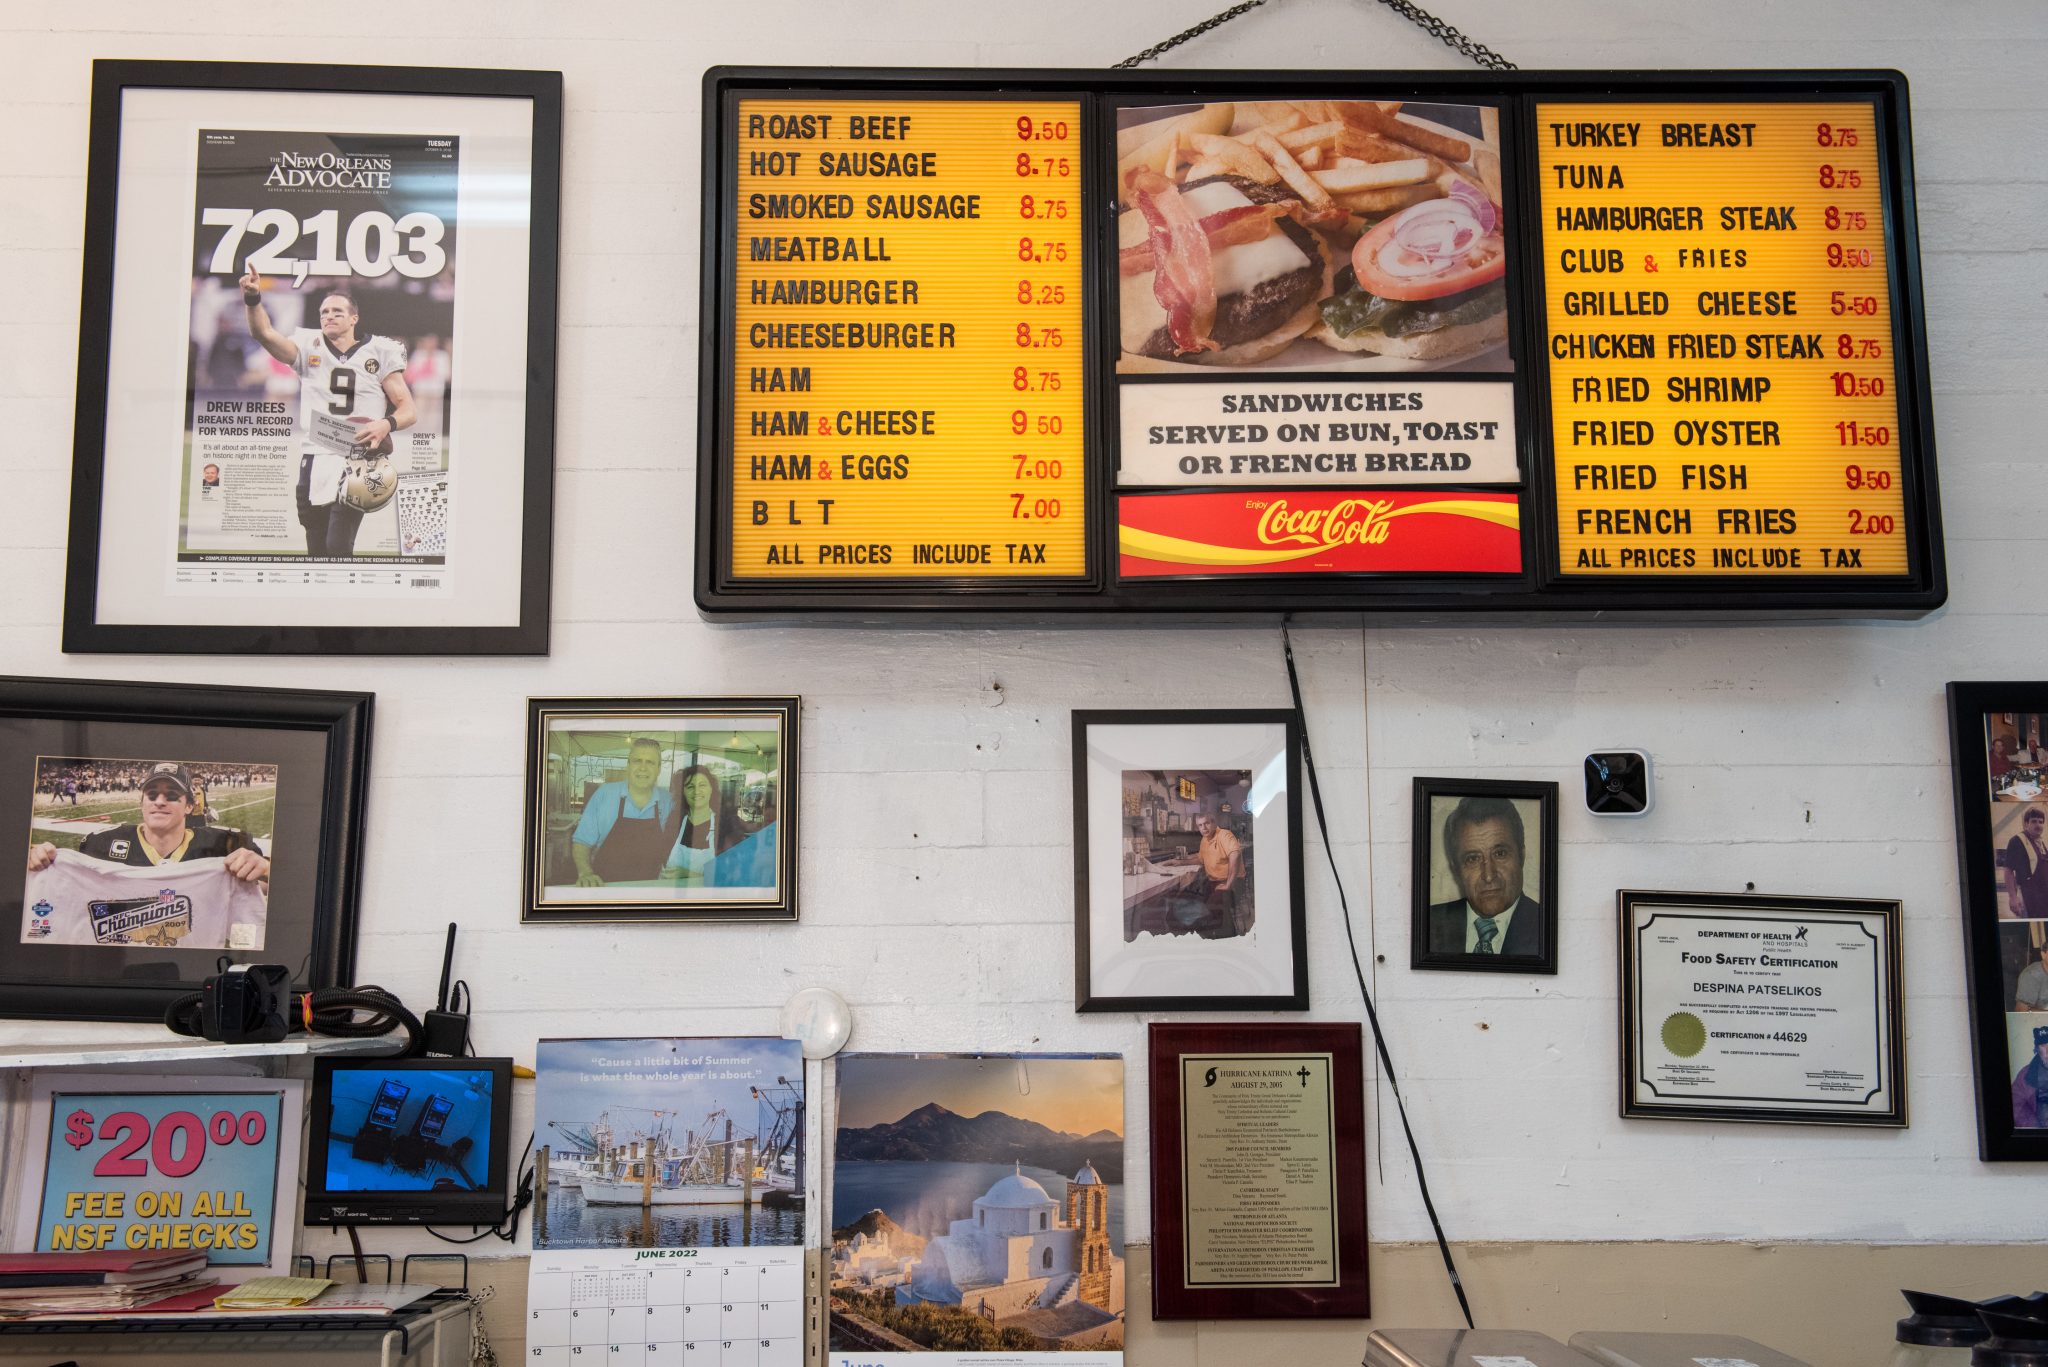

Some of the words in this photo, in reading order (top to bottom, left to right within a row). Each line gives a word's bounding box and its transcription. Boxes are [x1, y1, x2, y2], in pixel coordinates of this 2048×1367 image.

[749, 114, 832, 140] ROAST
[850, 116, 912, 140] BEEF
[1016, 116, 1068, 141] 9.50
[1550, 122, 1641, 148] TURKEY
[1662, 123, 1757, 148] BREAST
[1817, 122, 1858, 147] 8.75
[264, 163, 391, 189] ADVOCATE
[750, 151, 800, 177] HOT
[819, 152, 937, 177] SAUSAGE
[1016, 152, 1070, 177] 8.75
[1553, 165, 1624, 190] TUNA
[1819, 164, 1861, 189] 8.75
[749, 194, 854, 220] SMOKED
[866, 195, 981, 220] SAUSAGE
[1020, 194, 1068, 219] 8.75
[1556, 206, 1703, 232] HAMBURGER
[1721, 206, 1798, 232] STEAK
[202, 208, 446, 289] 72,103
[750, 236, 891, 262] MEATBALL
[1560, 249, 1624, 274] CLUB
[1644, 254, 1659, 273] &
[1678, 249, 1748, 269] FRIES
[1826, 243, 1872, 268] 9.50
[751, 280, 919, 306] HAMBURGER
[1017, 279, 1065, 305] 8.25
[1564, 291, 1669, 316] GRILLED
[1698, 291, 1798, 316] CHEESE
[749, 323, 956, 348] CHEESEBURGER
[1016, 322, 1063, 348] 8.75
[1551, 333, 1655, 360] CHICKEN
[1668, 334, 1737, 360] FRIED
[1746, 334, 1824, 360] STEAK
[1837, 333, 1882, 359] 8.75
[328, 367, 356, 416] 9
[750, 367, 812, 393] HAM
[1013, 366, 1061, 391] 8.75
[1572, 376, 1649, 403] FRIED
[1667, 376, 1771, 403] SHRIMP
[1830, 372, 1884, 397] 10.50
[207, 401, 243, 413] DREW
[246, 402, 286, 413] BREES
[1222, 392, 1423, 413] SANDWICHES
[198, 415, 234, 425] BREAKS
[237, 416, 253, 425] NFL
[256, 416, 293, 425] RECORD
[199, 427, 217, 436] FOR
[220, 427, 249, 436] YARDS
[252, 427, 291, 437] PASSING
[751, 410, 809, 437] HAM
[818, 418, 832, 437] &
[836, 410, 936, 436] CHEESE
[1572, 420, 1654, 447] FRIED
[1674, 419, 1781, 446] OYSTER
[1835, 421, 1890, 446] 11.50
[1149, 424, 1269, 445] SERVED
[1277, 424, 1320, 443] ON
[235, 452, 250, 460] night
[273, 445, 288, 453] great
[751, 454, 812, 481] HAM
[818, 461, 832, 480] &
[842, 454, 910, 480] EGGS
[1012, 454, 1062, 479] 7.00
[1178, 455, 1223, 474] OR
[1230, 454, 1360, 473] FRENCH
[1364, 452, 1472, 472] BREAD
[1574, 465, 1657, 490] FRIED
[1682, 464, 1748, 490] FISH
[1845, 464, 1891, 490] 9.50
[1010, 493, 1061, 518] 7.00
[1245, 499, 1268, 510] Enjoy
[1257, 498, 1395, 545] Coca-Cola
[1577, 509, 1692, 535] FRENCH
[1718, 508, 1797, 535] FRIES
[767, 544, 804, 565] ALL
[819, 544, 892, 565] PRICES
[913, 544, 992, 564] INCLUDE
[1006, 544, 1047, 564] TAX
[1577, 548, 1611, 569] ALL
[1620, 548, 1696, 569] PRICES
[1713, 548, 1801, 569] INCLUDE
[1821, 548, 1863, 569] TAX
[97, 899, 186, 937] Champions
[165, 920, 186, 928] 2009
[1698, 930, 1748, 939] DEPARTMENT
[1693, 983, 1744, 994] DESPINA
[1748, 984, 1822, 996] PATSELIKOS
[1710, 1031, 1765, 1040] CERTIFICATION
[1773, 1031, 1807, 1043] 44629
[634, 1059, 641, 1067] a
[644, 1057, 670, 1067] little
[673, 1056, 689, 1066] bit
[691, 1056, 703, 1065] of
[705, 1056, 752, 1066] Summer
[1220, 1070, 1262, 1078] HURRICANE
[580, 1073, 589, 1082] is
[592, 1073, 621, 1082] what
[623, 1072, 643, 1082] the
[646, 1071, 679, 1081] whole
[681, 1073, 707, 1083] year
[708, 1071, 718, 1080] is
[65, 1190, 126, 1218] FEE
[134, 1190, 184, 1218] ON
[191, 1190, 251, 1218] ALL
[51, 1222, 116, 1250] NSF
[125, 1222, 259, 1250] CHECKS
[634, 1251, 666, 1261] JUNE
